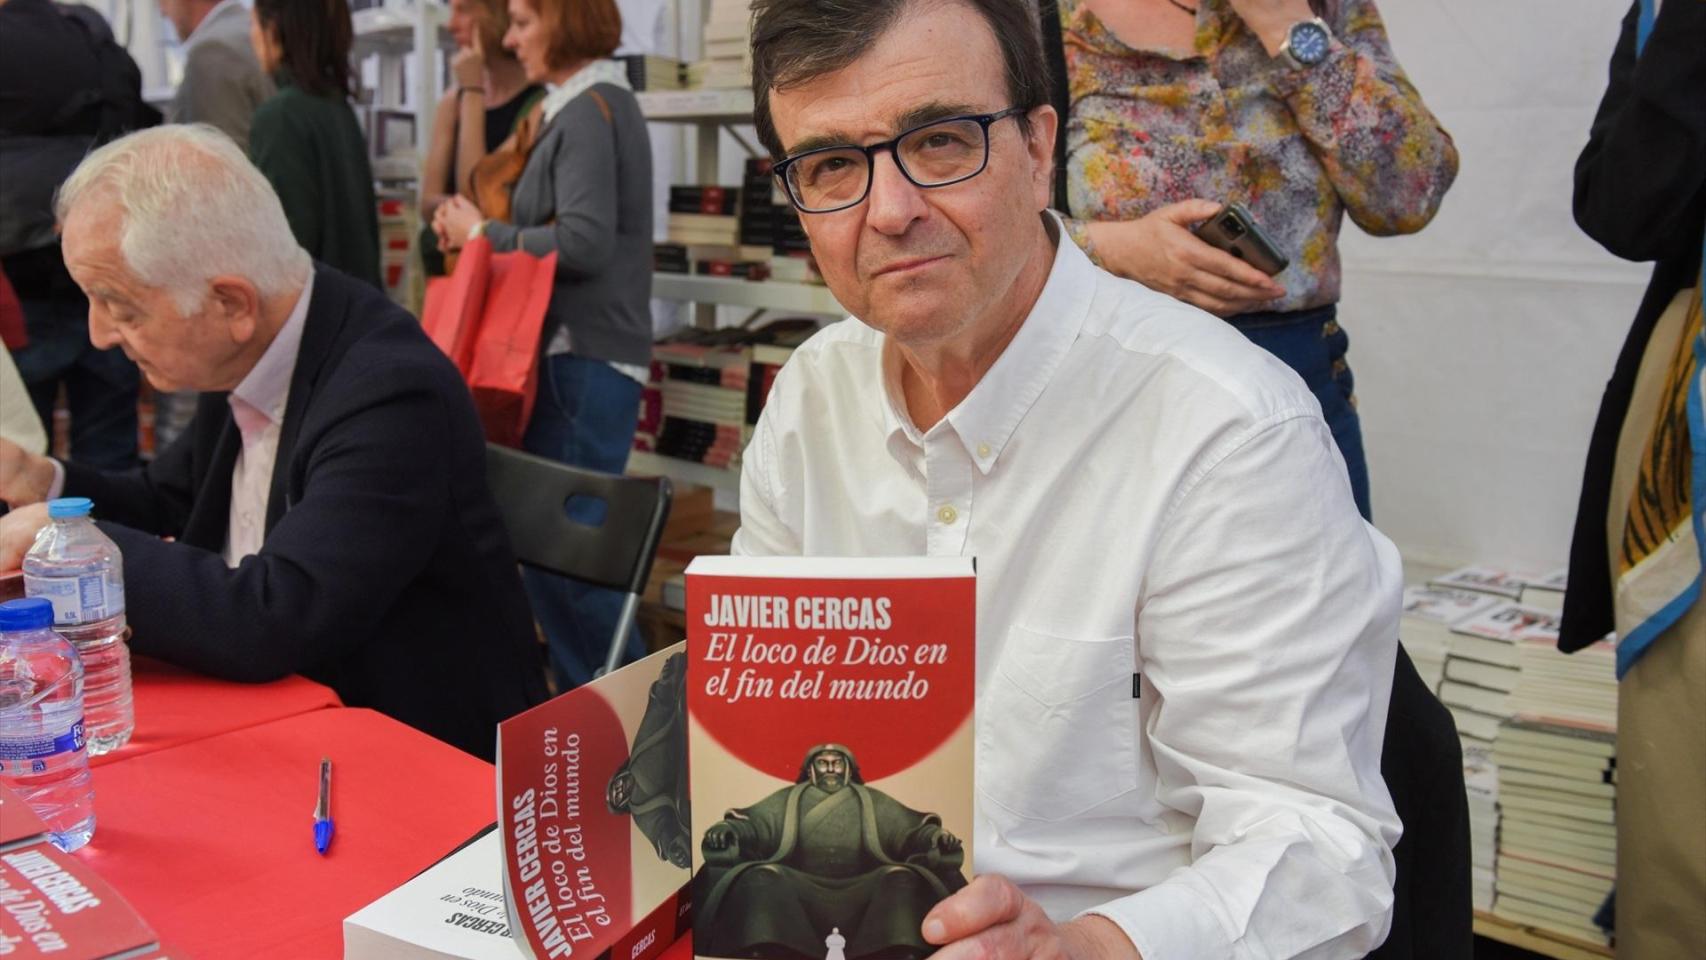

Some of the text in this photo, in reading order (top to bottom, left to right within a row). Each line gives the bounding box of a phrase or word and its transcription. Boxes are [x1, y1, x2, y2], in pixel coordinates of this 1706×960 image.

[704, 594, 892, 630] JAVIER CERCAS
[704, 633, 947, 666] El loco de Dios en
[705, 668, 929, 703] el fin del mundo
[540, 727, 594, 943] El loco de Dios en
[561, 732, 612, 926] el fin del mundo
[512, 788, 573, 960] JAVIER CERCAS
[445, 913, 506, 935] CERCAS
